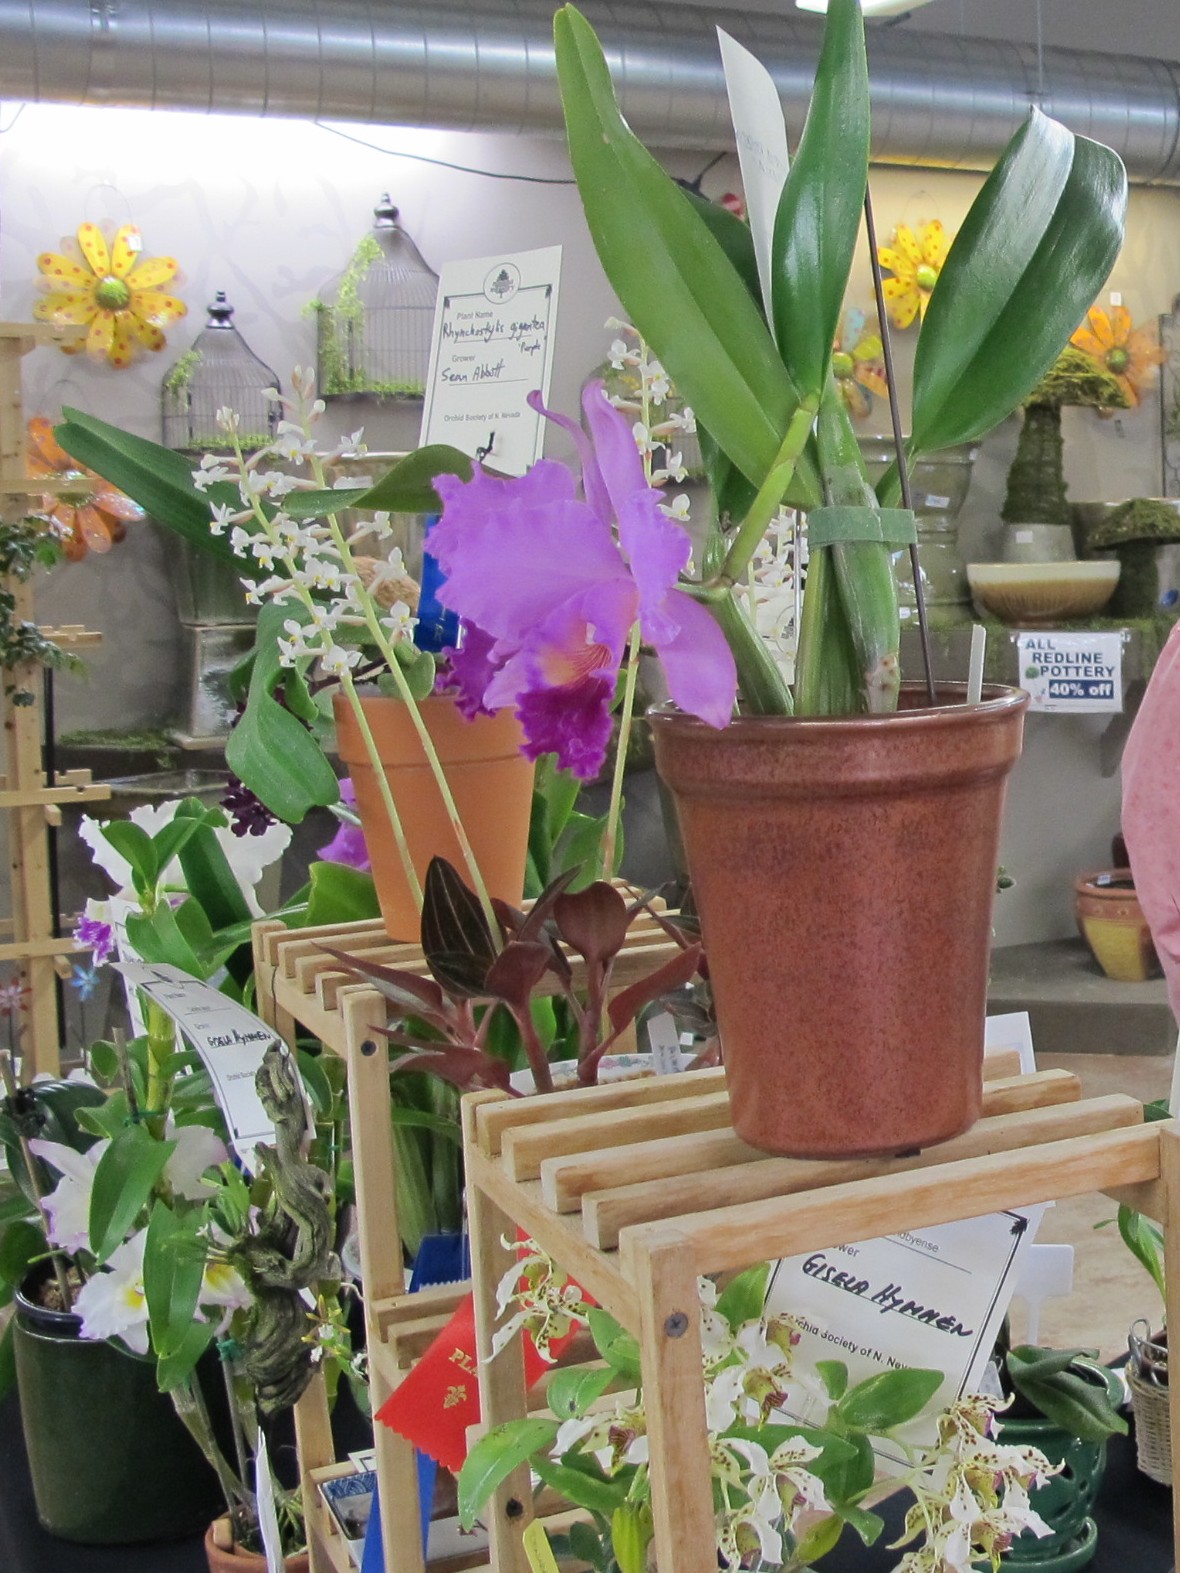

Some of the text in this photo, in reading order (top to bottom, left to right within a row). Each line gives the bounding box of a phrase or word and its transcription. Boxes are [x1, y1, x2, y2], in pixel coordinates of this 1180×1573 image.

[442, 358, 505, 382] Sean Abbott
[1025, 639, 1056, 650] ALL
[1032, 652, 1103, 663] REDLINE
[1040, 666, 1116, 677] POTTERY
[1050, 682, 1112, 697] 40% off
[802, 1253, 869, 1295] GISELA
[794, 1318, 819, 1336] rchid
[821, 1330, 858, 1354] Society
[860, 1347, 873, 1358] of
[873, 1350, 884, 1363] N.
